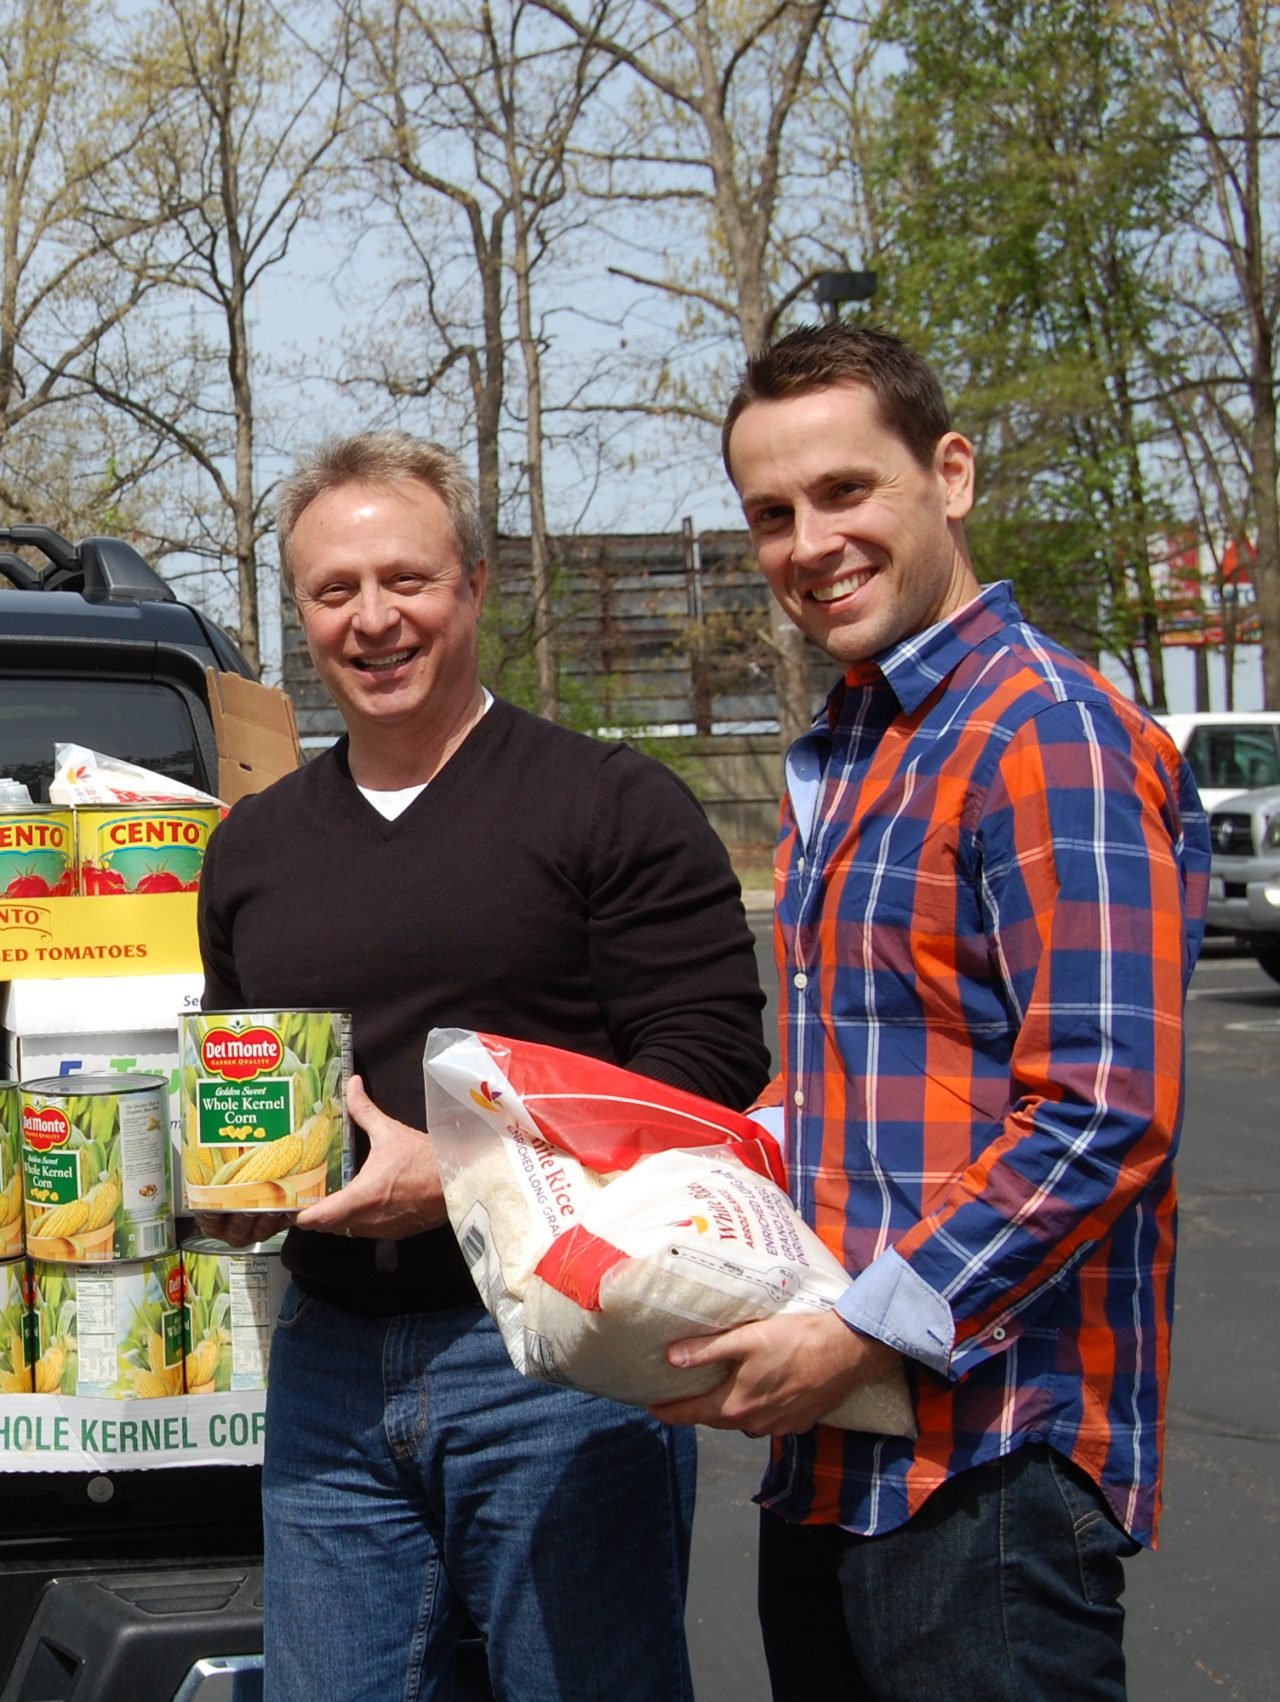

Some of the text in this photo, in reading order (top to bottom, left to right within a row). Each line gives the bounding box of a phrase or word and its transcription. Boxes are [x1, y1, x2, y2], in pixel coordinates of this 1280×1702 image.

[109, 821, 200, 845] CENTO
[36, 944, 148, 961] TOMATOES
[205, 1040, 277, 1059] Del Monte
[238, 1058, 270, 1066] QUALITY
[215, 1086, 267, 1097] Golden Sweet
[202, 1096, 285, 1111] Whole Kernel
[32, 1117, 66, 1133] Monte
[224, 1111, 257, 1124] Corn
[42, 1165, 73, 1178] Kernel
[506, 1124, 562, 1238] ENRICHED LONG GRAI
[32, 1176, 53, 1188] Corn
[545, 1168, 576, 1217] Rice
[754, 1184, 781, 1219] LARGO
[707, 1200, 738, 1241] White
[749, 1200, 778, 1257] ENRICHED
[773, 1219, 797, 1262] GRANO
[81, 1416, 198, 1453] KERNEL
[209, 1412, 266, 1447] COR
